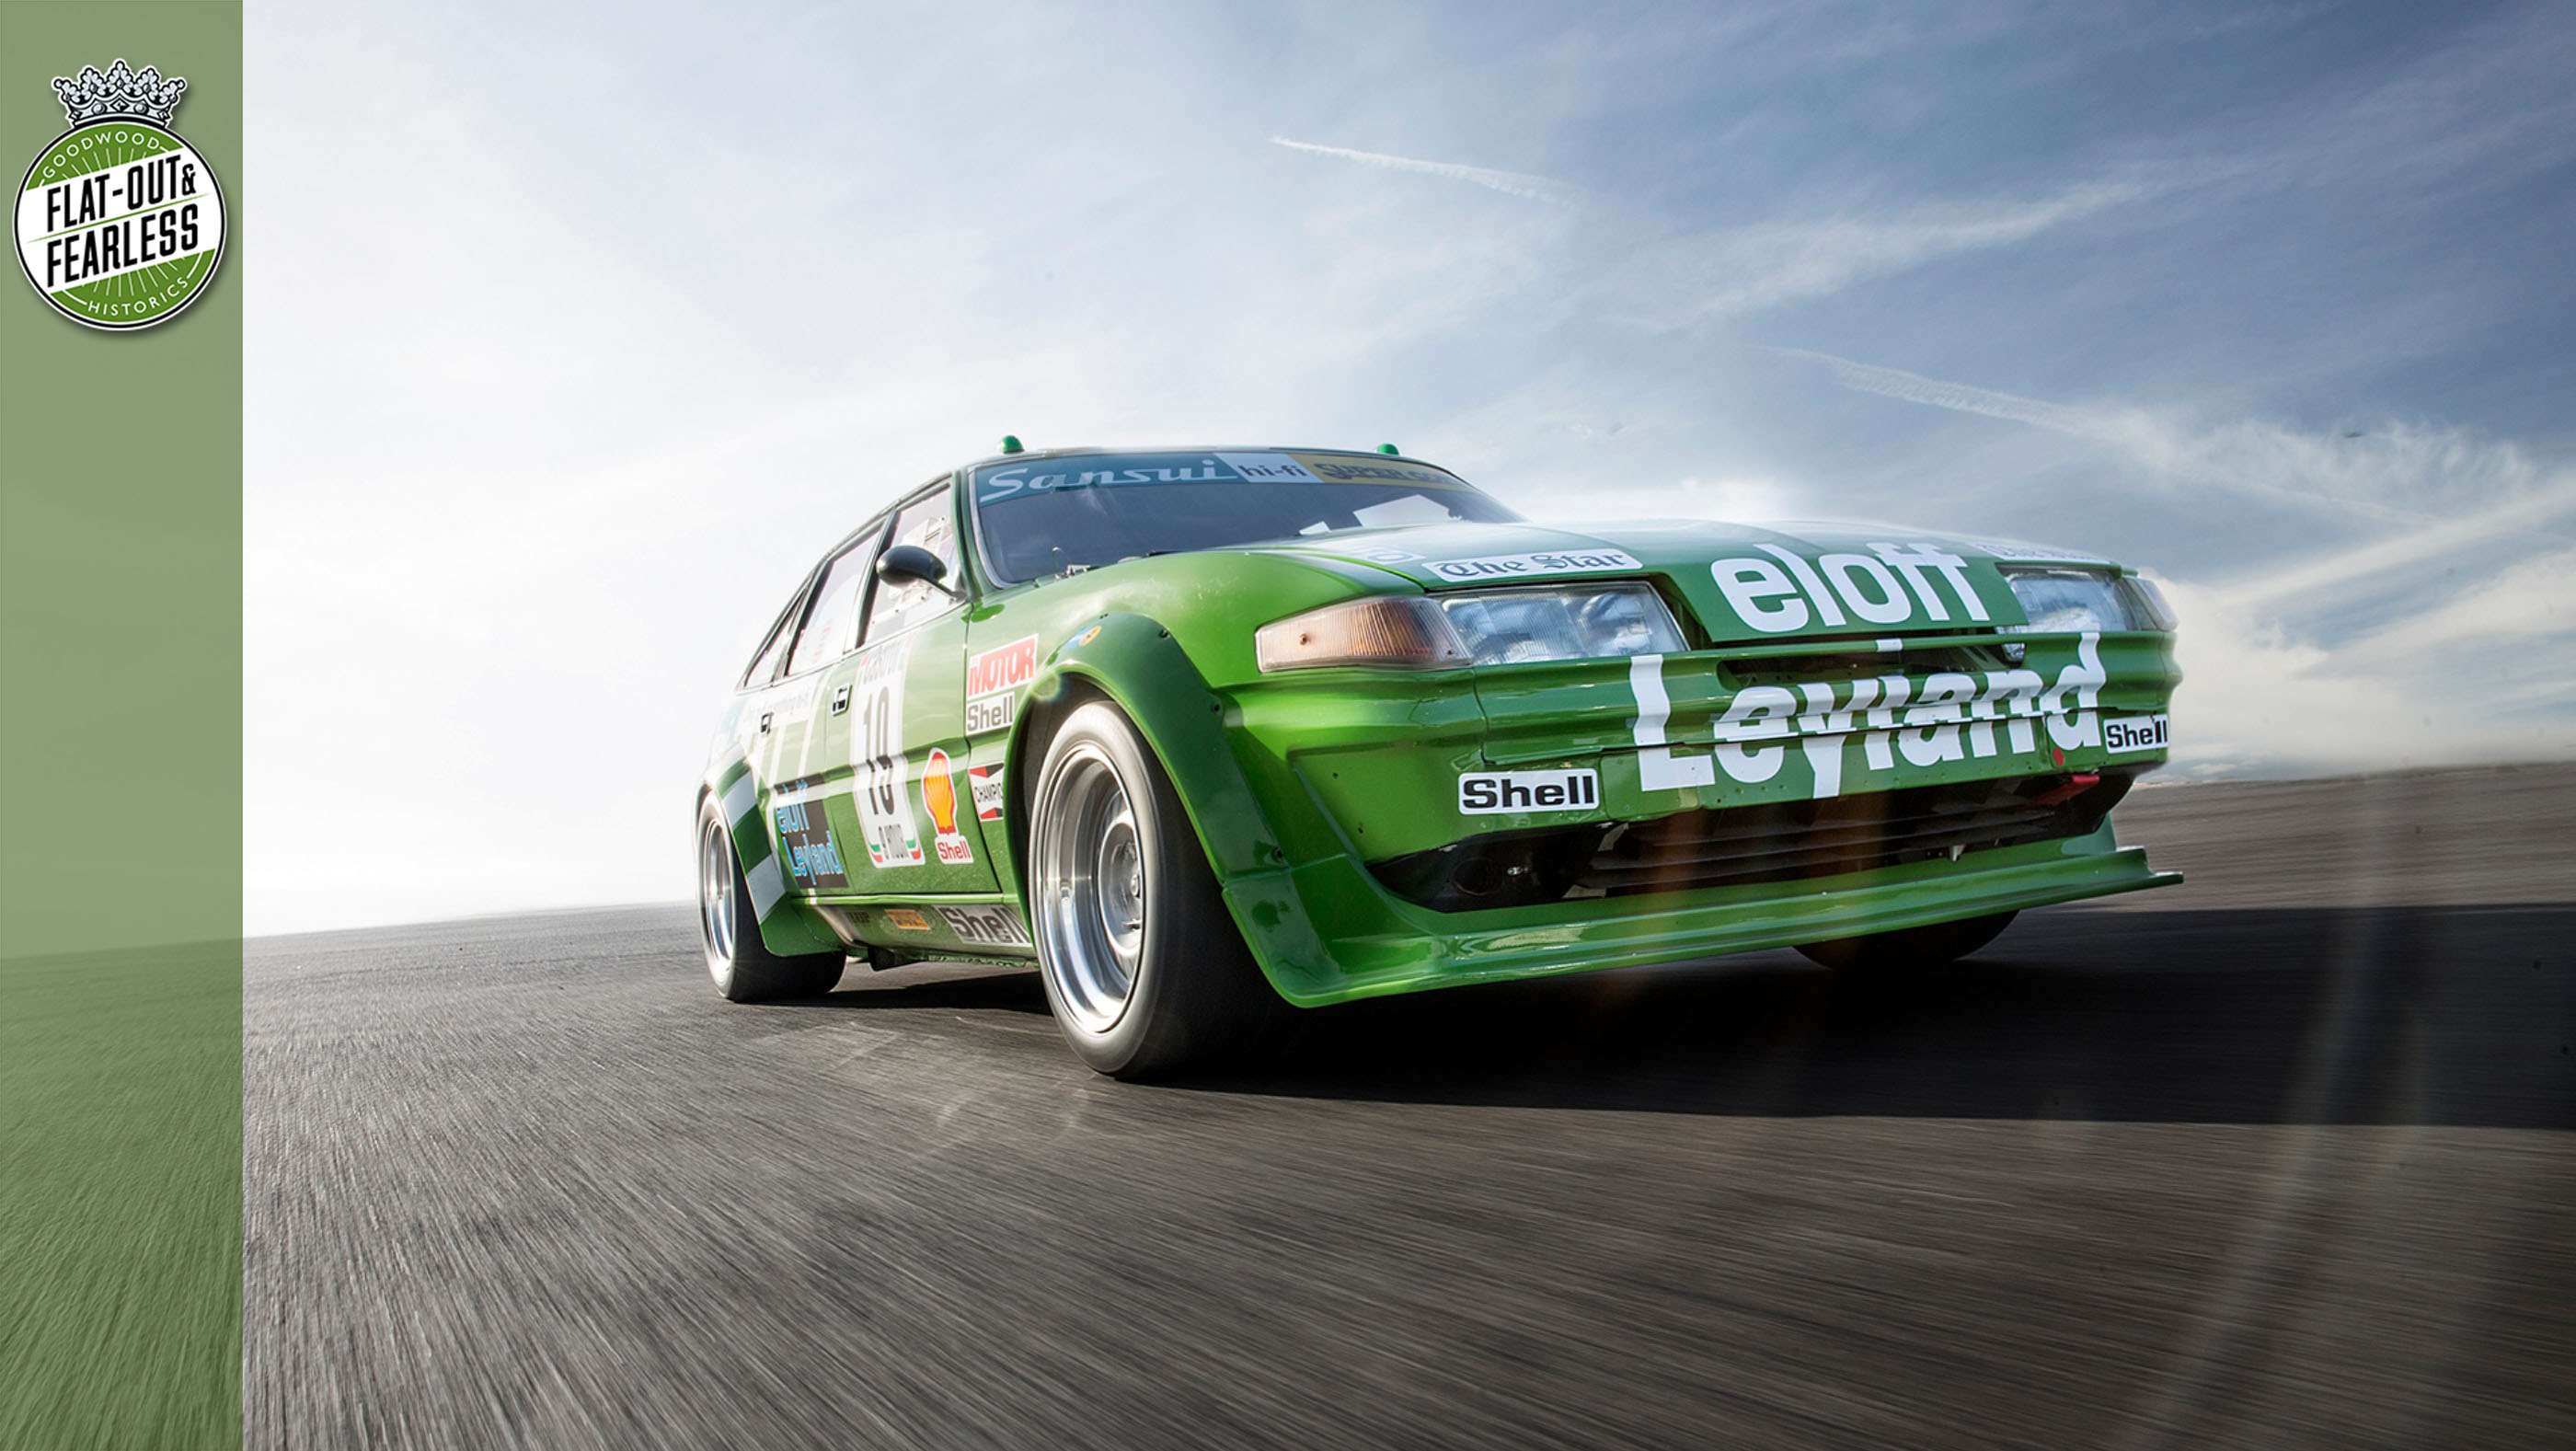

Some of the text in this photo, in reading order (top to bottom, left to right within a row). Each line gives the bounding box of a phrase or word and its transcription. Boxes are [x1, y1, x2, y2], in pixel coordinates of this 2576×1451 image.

[979, 459, 1238, 503] Sansui
[1241, 463, 1308, 478] hi-fi
[1440, 551, 1625, 578] The Star
[1710, 541, 1991, 633] eloff
[969, 636, 1035, 697] MOTOR
[967, 695, 1014, 732] Shell
[1629, 631, 2108, 800] Leyland
[2105, 720, 2168, 749] Shell
[1463, 775, 1595, 809] Shell
[937, 840, 972, 860] Shell
[937, 906, 1032, 944] Shell
